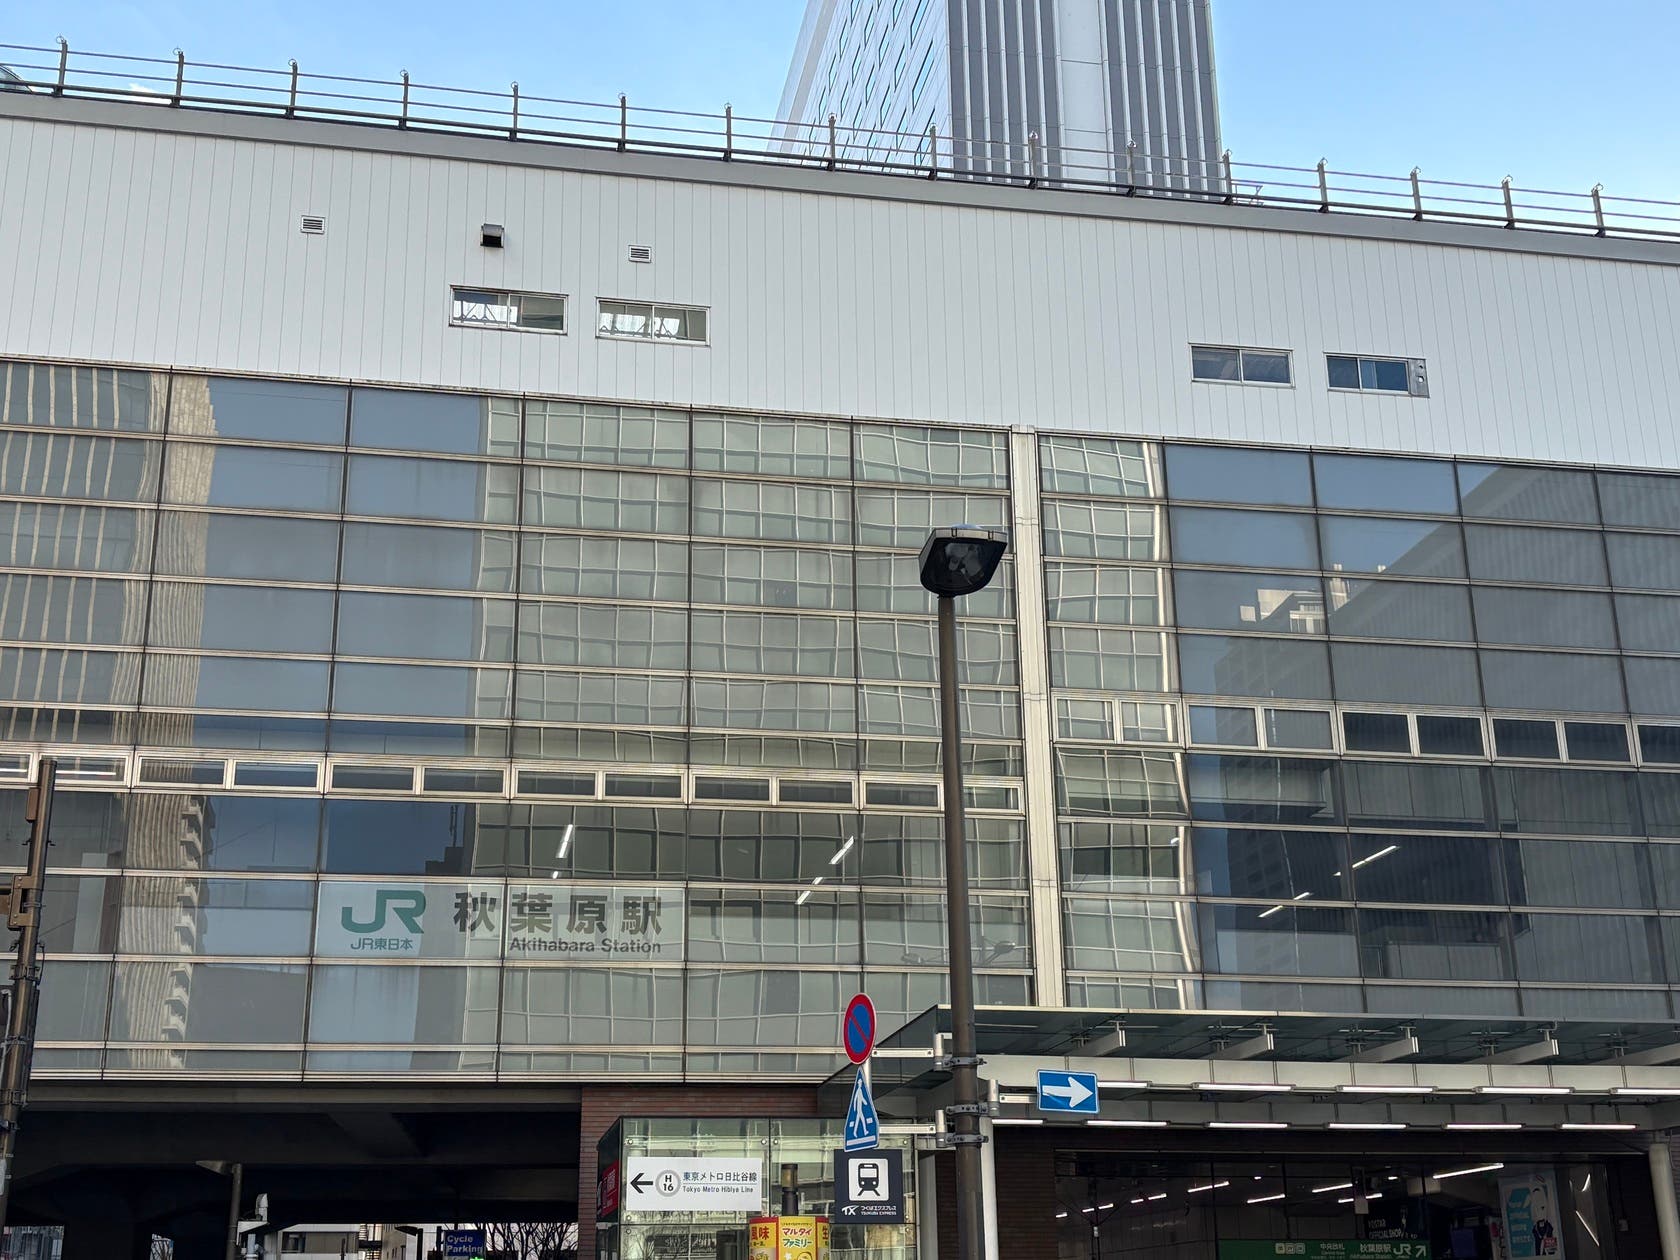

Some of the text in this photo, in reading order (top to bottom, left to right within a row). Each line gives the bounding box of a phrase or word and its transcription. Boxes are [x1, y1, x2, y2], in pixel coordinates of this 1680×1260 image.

[341, 889, 426, 934] JR
[453, 891, 662, 936] 秋葉原駅
[350, 937, 413, 951] JR東日本
[509, 936, 661, 953] Akihabara Station
[664, 1174, 672, 1183] H
[682, 1171, 757, 1182] 東京メトロ日比谷線
[663, 1183, 674, 1192] 16
[682, 1185, 753, 1193] Tokyo Metro Hibiya Line
[782, 1227, 812, 1236] マルタイ
[447, 1234, 473, 1244] Cycle
[782, 1238, 812, 1248] ファミリー
[447, 1245, 483, 1254] Parking
[1392, 1243, 1412, 1256] JR
